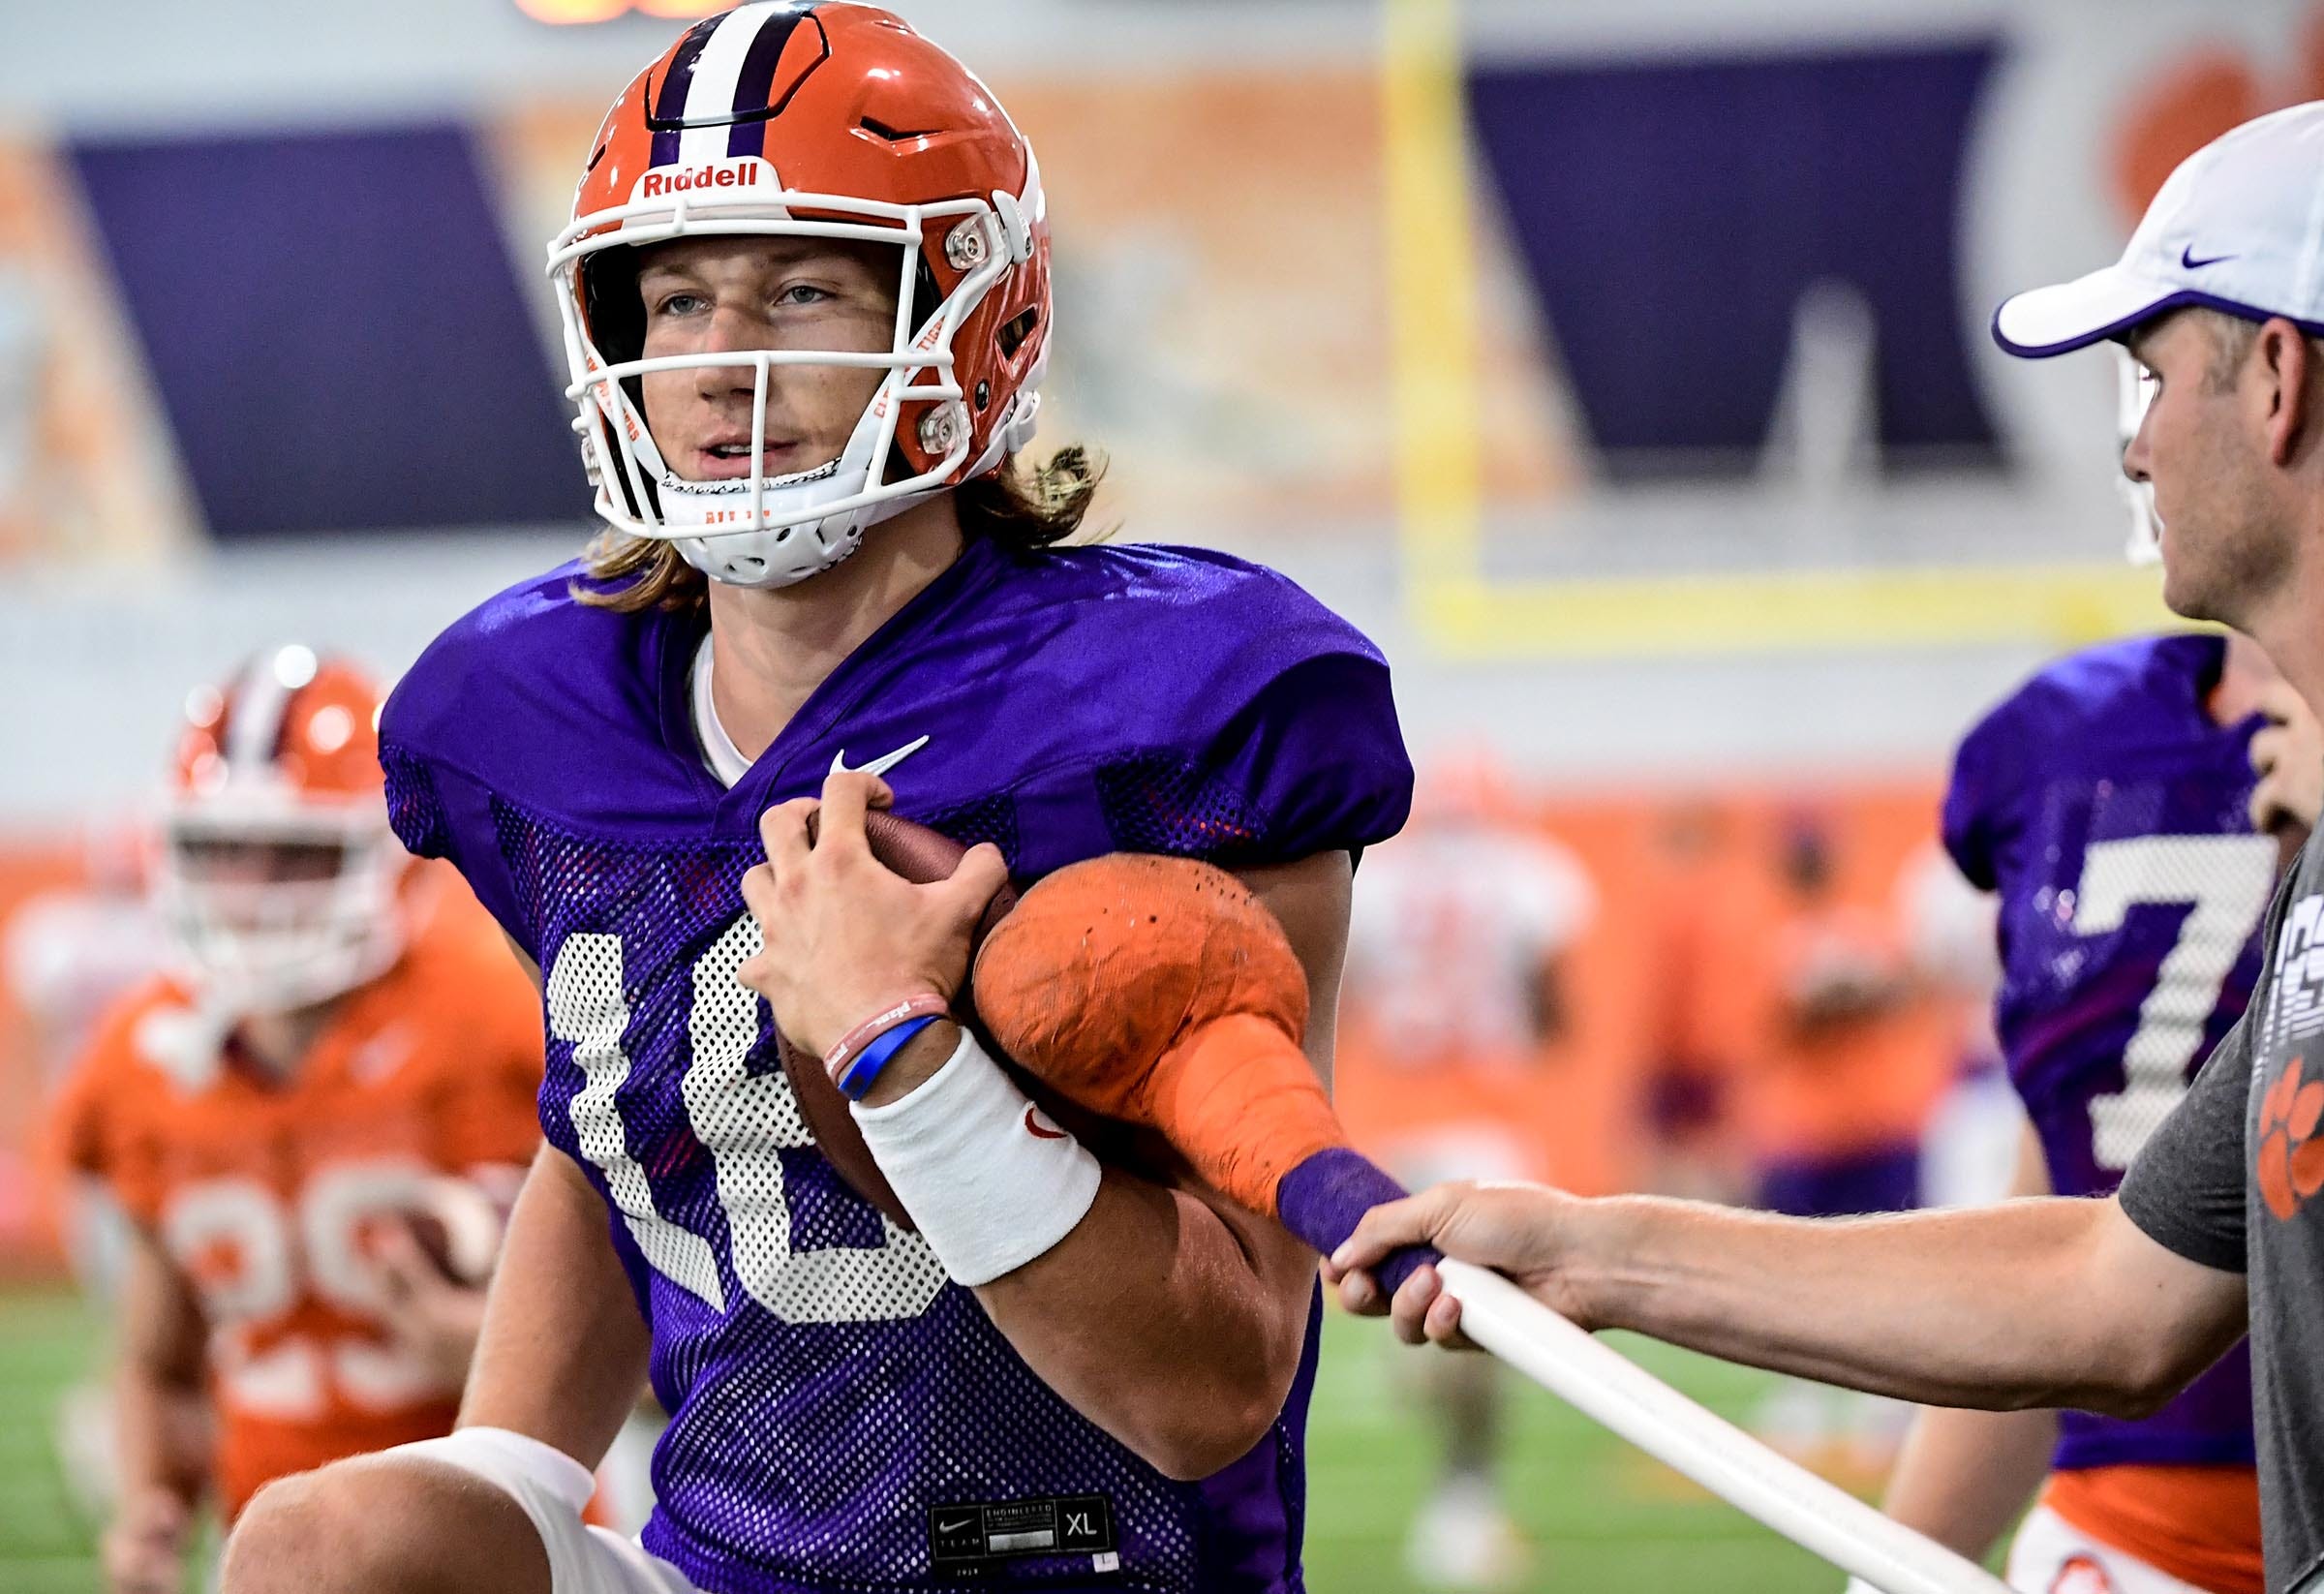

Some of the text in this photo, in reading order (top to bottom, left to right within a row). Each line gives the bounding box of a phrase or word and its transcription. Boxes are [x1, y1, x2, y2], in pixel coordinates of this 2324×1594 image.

[644, 163, 757, 199] Riddell
[2074, 833, 2280, 1172] 7
[546, 911, 950, 1325] 16
[1065, 1512, 1098, 1537] XL
